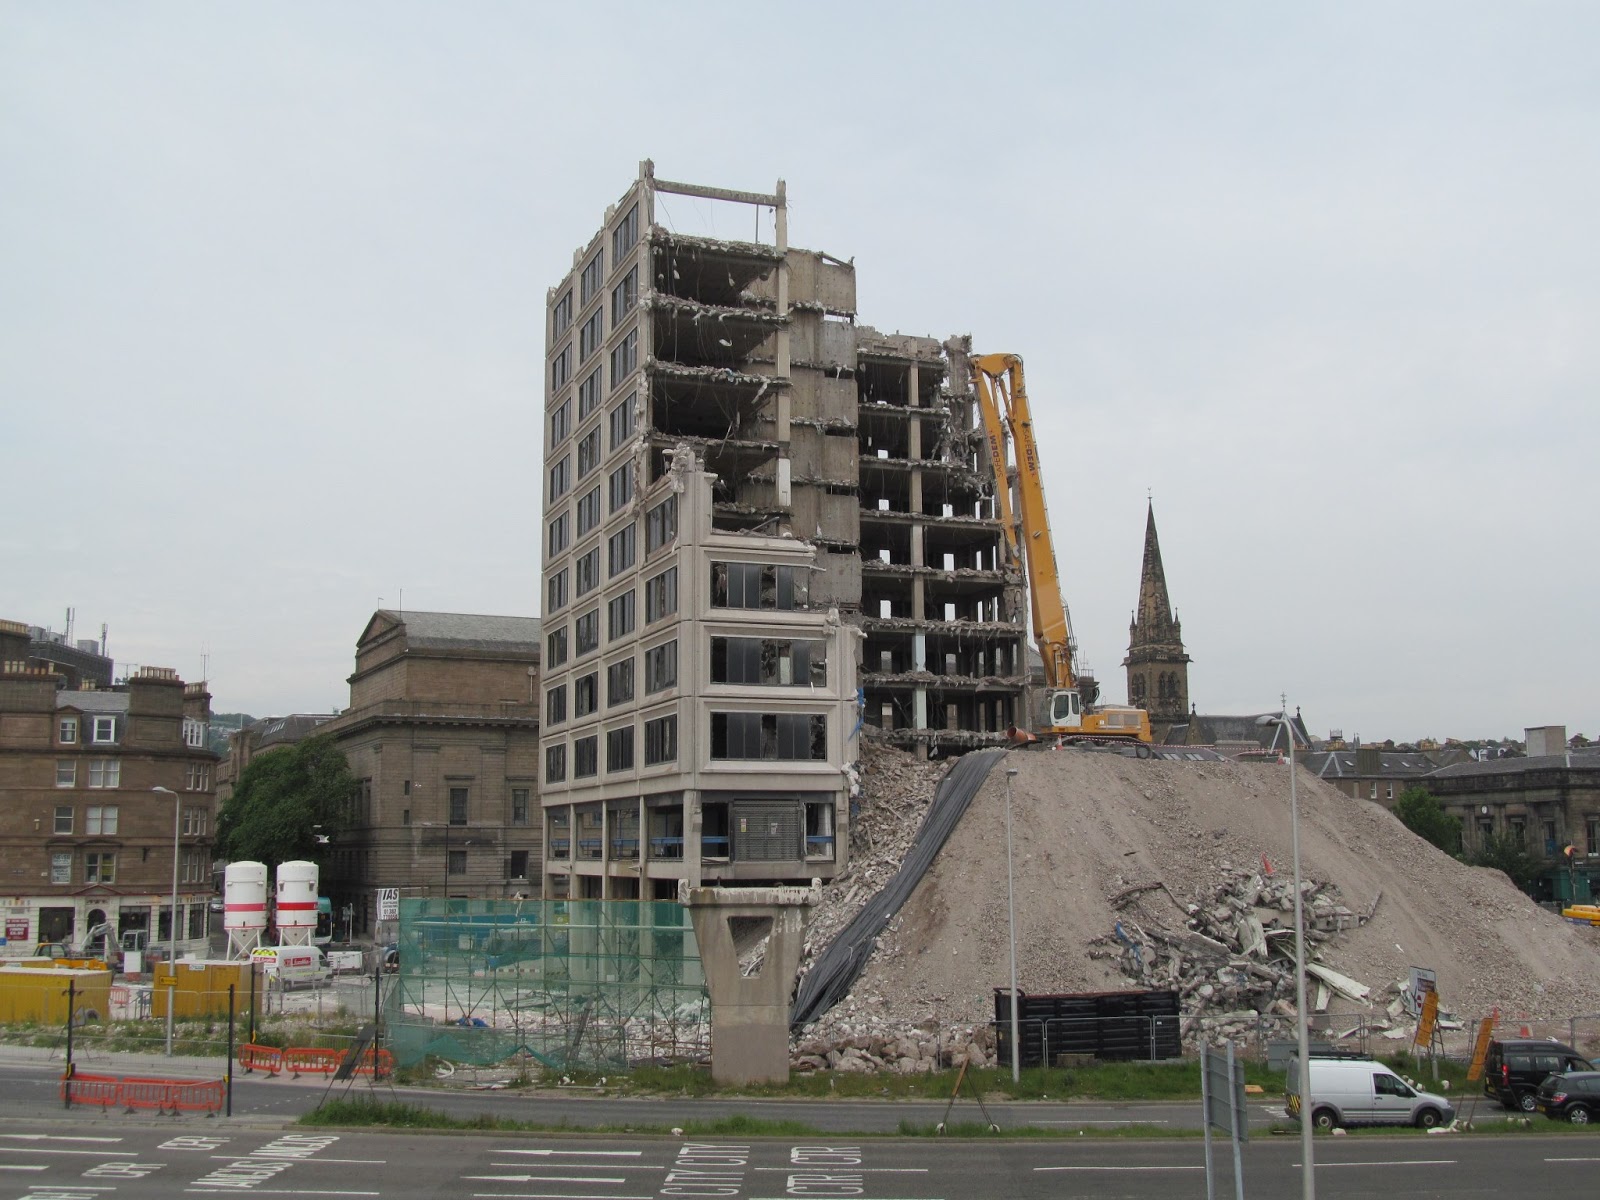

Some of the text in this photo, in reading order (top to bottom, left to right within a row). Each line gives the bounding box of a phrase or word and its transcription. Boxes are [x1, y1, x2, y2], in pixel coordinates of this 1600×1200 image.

[990, 435, 1004, 478] SAFEDEM
[250, 1134, 340, 1159] ANGUS
[675, 1142, 750, 1165] CITY
[790, 1146, 862, 1165] CTR
[190, 1160, 293, 1188] ANGUS
[660, 1168, 745, 1195] CITY
[786, 1174, 864, 1195] CTR
